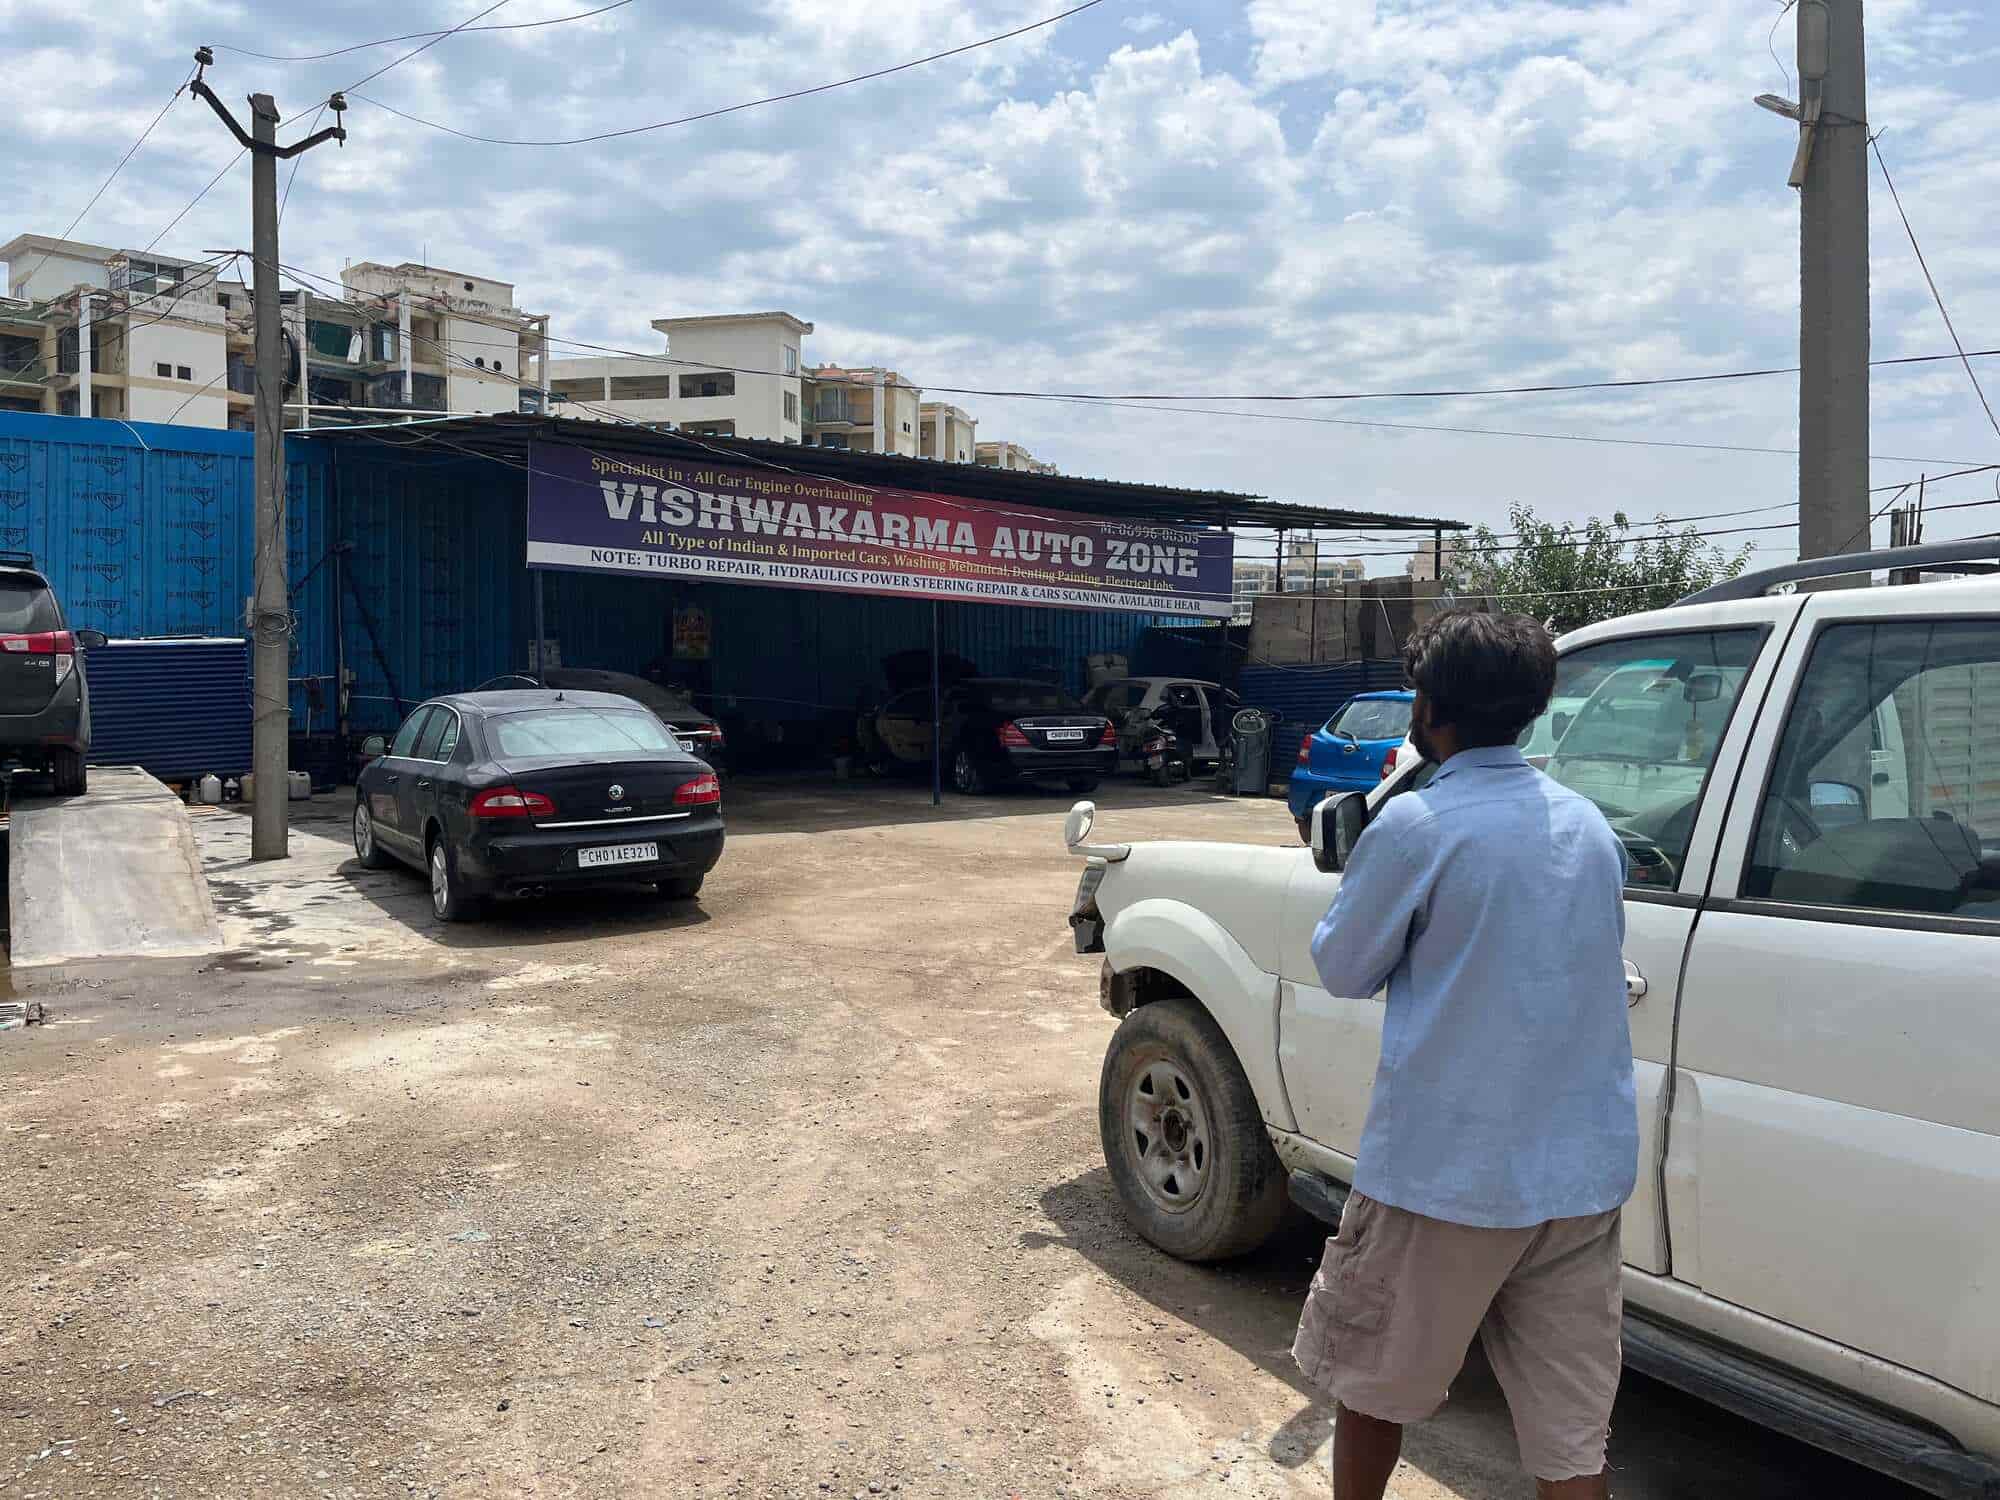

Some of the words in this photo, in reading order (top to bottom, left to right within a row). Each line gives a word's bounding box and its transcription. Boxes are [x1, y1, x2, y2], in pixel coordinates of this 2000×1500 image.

[591, 457, 665, 480] Specialist
[669, 466, 683, 481] in
[694, 471, 714, 485] All
[718, 474, 741, 488] Car
[745, 476, 791, 495] Engine
[794, 483, 873, 506] Overhauling
[600, 480, 978, 555] VISHWAKARMA
[990, 526, 1093, 567] AUTO
[1105, 540, 1199, 578] ZONE
[591, 549, 641, 566] NOTE:
[645, 554, 701, 570] TURBO
[706, 559, 765, 577] REPAIR,
[769, 564, 858, 583] HYDRAULICS
[861, 573, 910, 588] POWER
[912, 576, 974, 593] STEERING
[976, 582, 1018, 597] REPAIR
[1020, 586, 1030, 597] &
[1032, 587, 1060, 600] CARS
[1062, 589, 1116, 605] SCANNING
[1118, 593, 1172, 609] AVAILABLE
[1174, 600, 1200, 611] HEAR
[642, 530, 663, 545] All
[667, 533, 705, 551] Type
[708, 537, 724, 550] of
[727, 538, 774, 555] Indian
[777, 543, 789, 556] &
[792, 544, 856, 562] Imported
[859, 551, 891, 566] Cars,
[894, 555, 946, 573] Washing
[1013, 567, 1055, 583] Denting
[1105, 575, 1151, 590] Electrical
[588, 845, 657, 863] CH01AE3210
